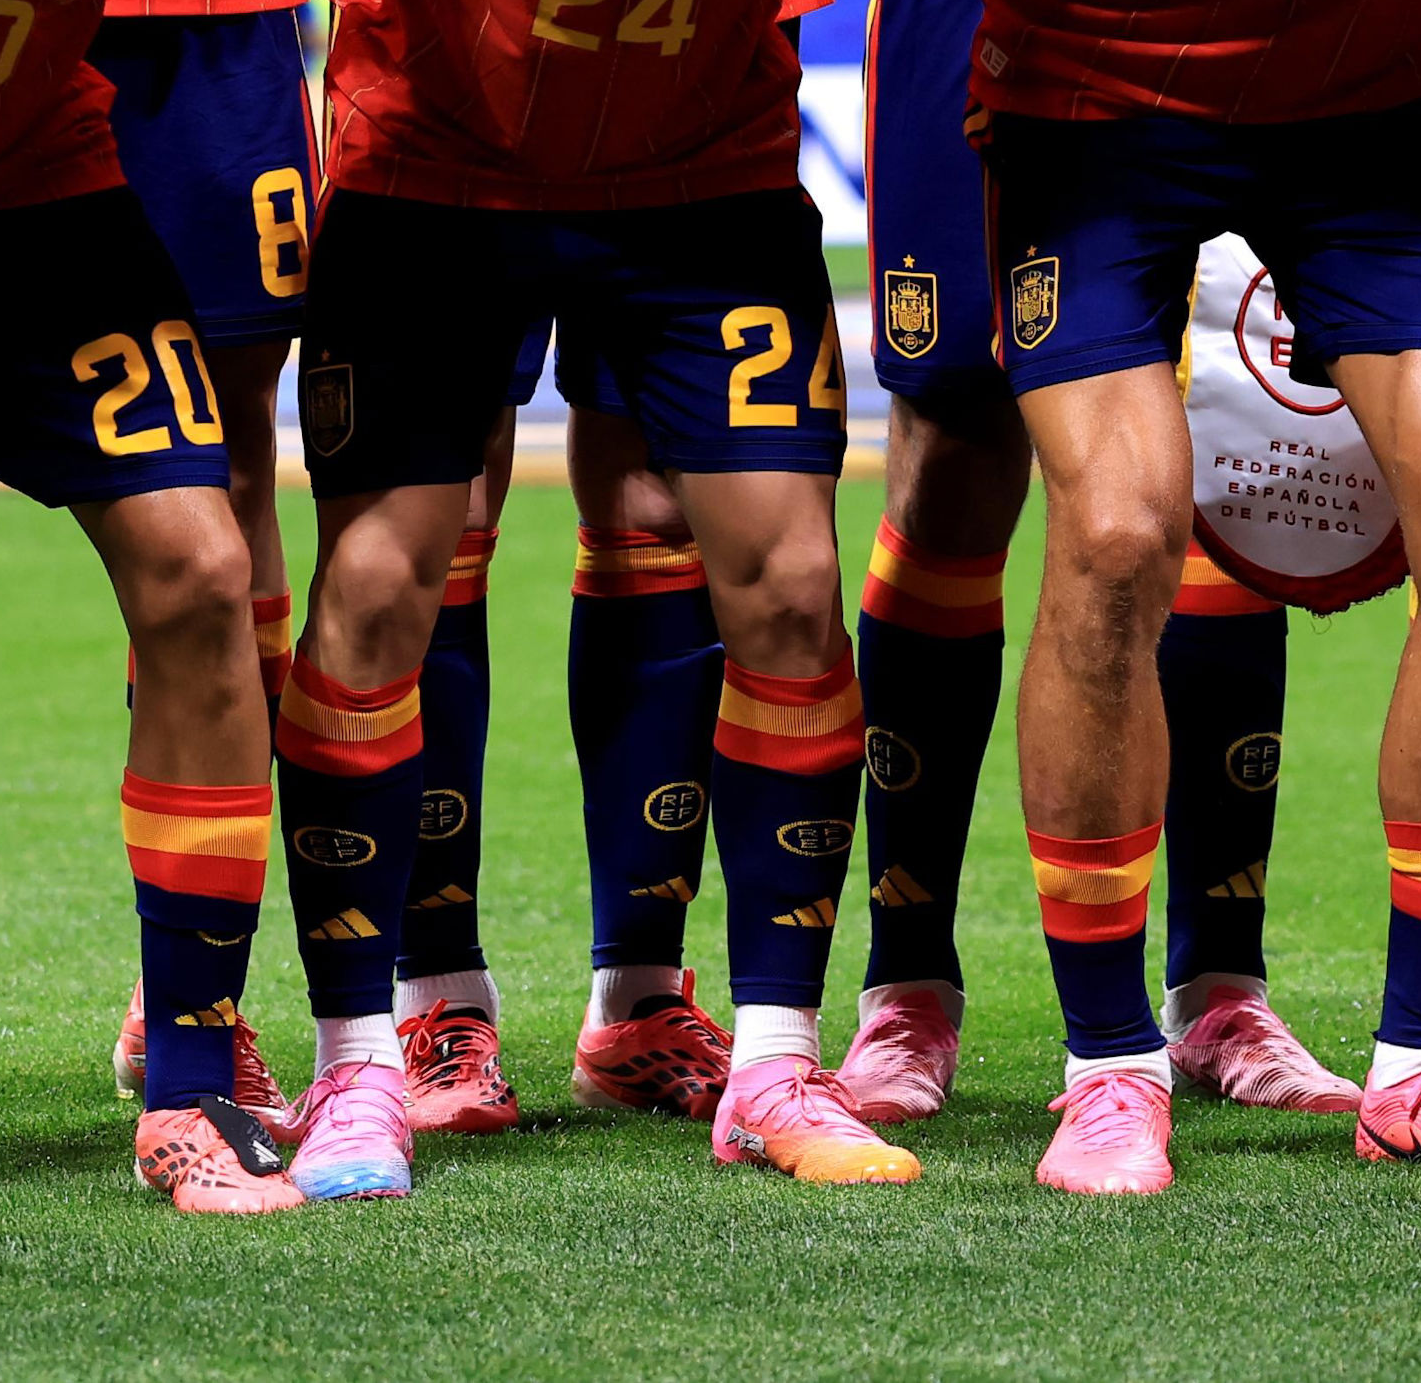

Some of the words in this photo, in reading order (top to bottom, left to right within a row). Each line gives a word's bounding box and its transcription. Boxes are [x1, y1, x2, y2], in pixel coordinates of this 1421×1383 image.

[252, 167, 308, 297] 8
[720, 303, 847, 431] 24
[71, 320, 225, 457] 20
[1269, 440, 1330, 461] REAL
[1214, 456, 1376, 492] FEDERACIÓN
[1228, 481, 1361, 514] ESPAÑOLA
[1220, 504, 1252, 520] DE
[1267, 510, 1366, 536] FÚTBOL
[1243, 744, 1278, 760] RF
[1242, 762, 1275, 778] EF
[421, 800, 455, 815] RF
[660, 790, 696, 806] RF
[419, 815, 454, 830] EF
[659, 806, 691, 821] EF
